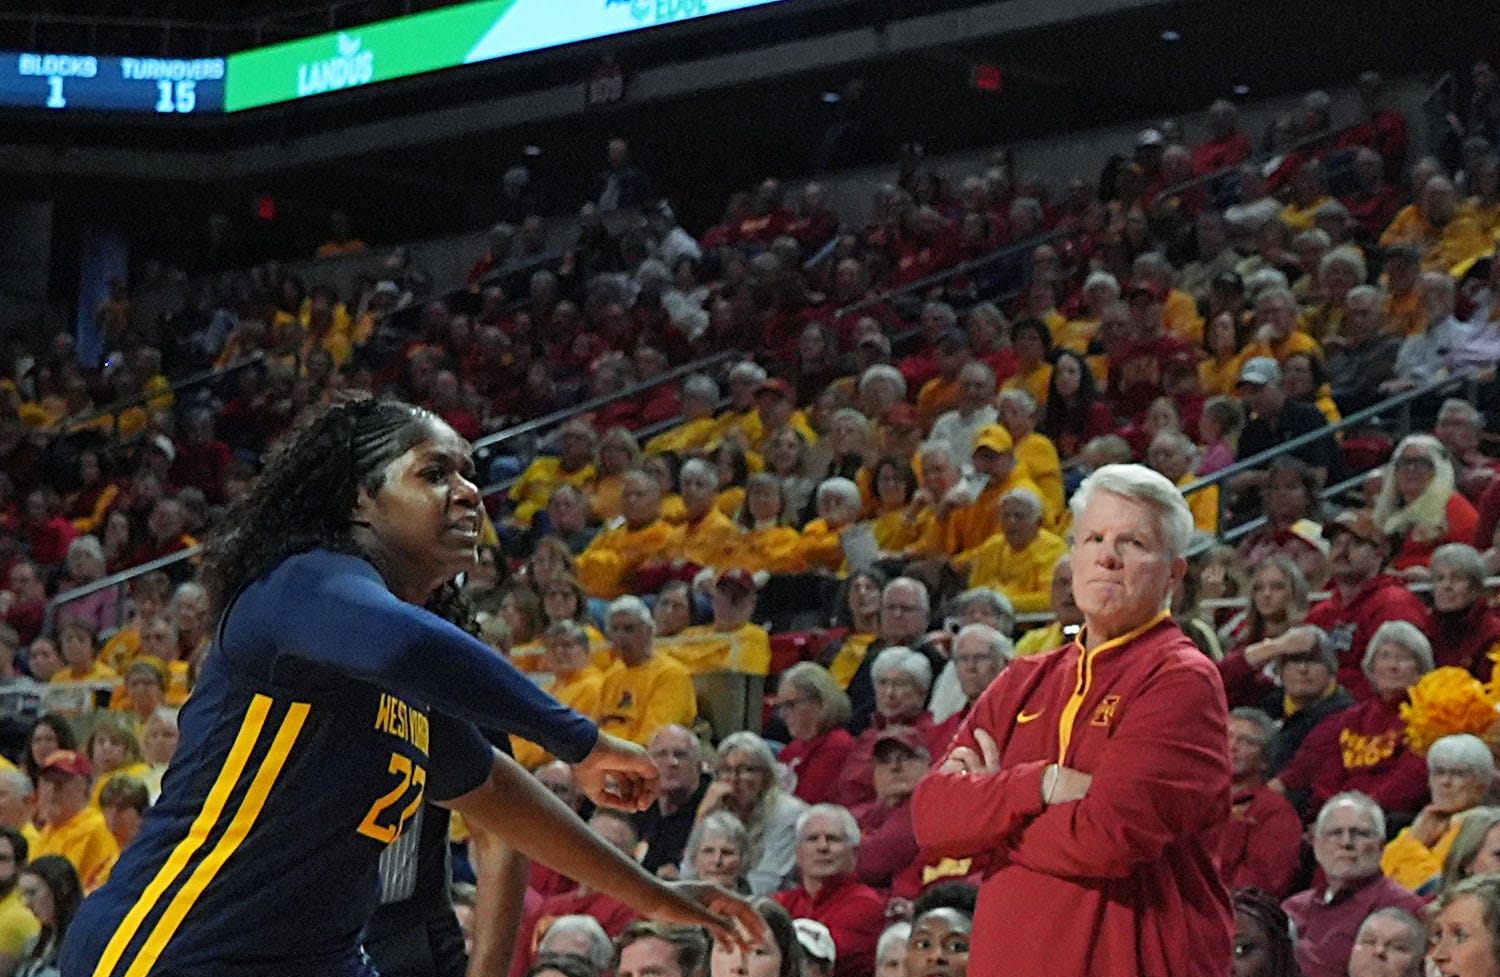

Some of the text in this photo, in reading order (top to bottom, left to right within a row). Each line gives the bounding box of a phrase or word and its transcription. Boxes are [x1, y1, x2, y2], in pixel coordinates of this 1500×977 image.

[19, 53, 97, 77] BLOCKS
[120, 57, 224, 80] TURNOVERS
[298, 50, 374, 96] LANDUS
[47, 76, 66, 108] 1
[156, 79, 196, 112] 15
